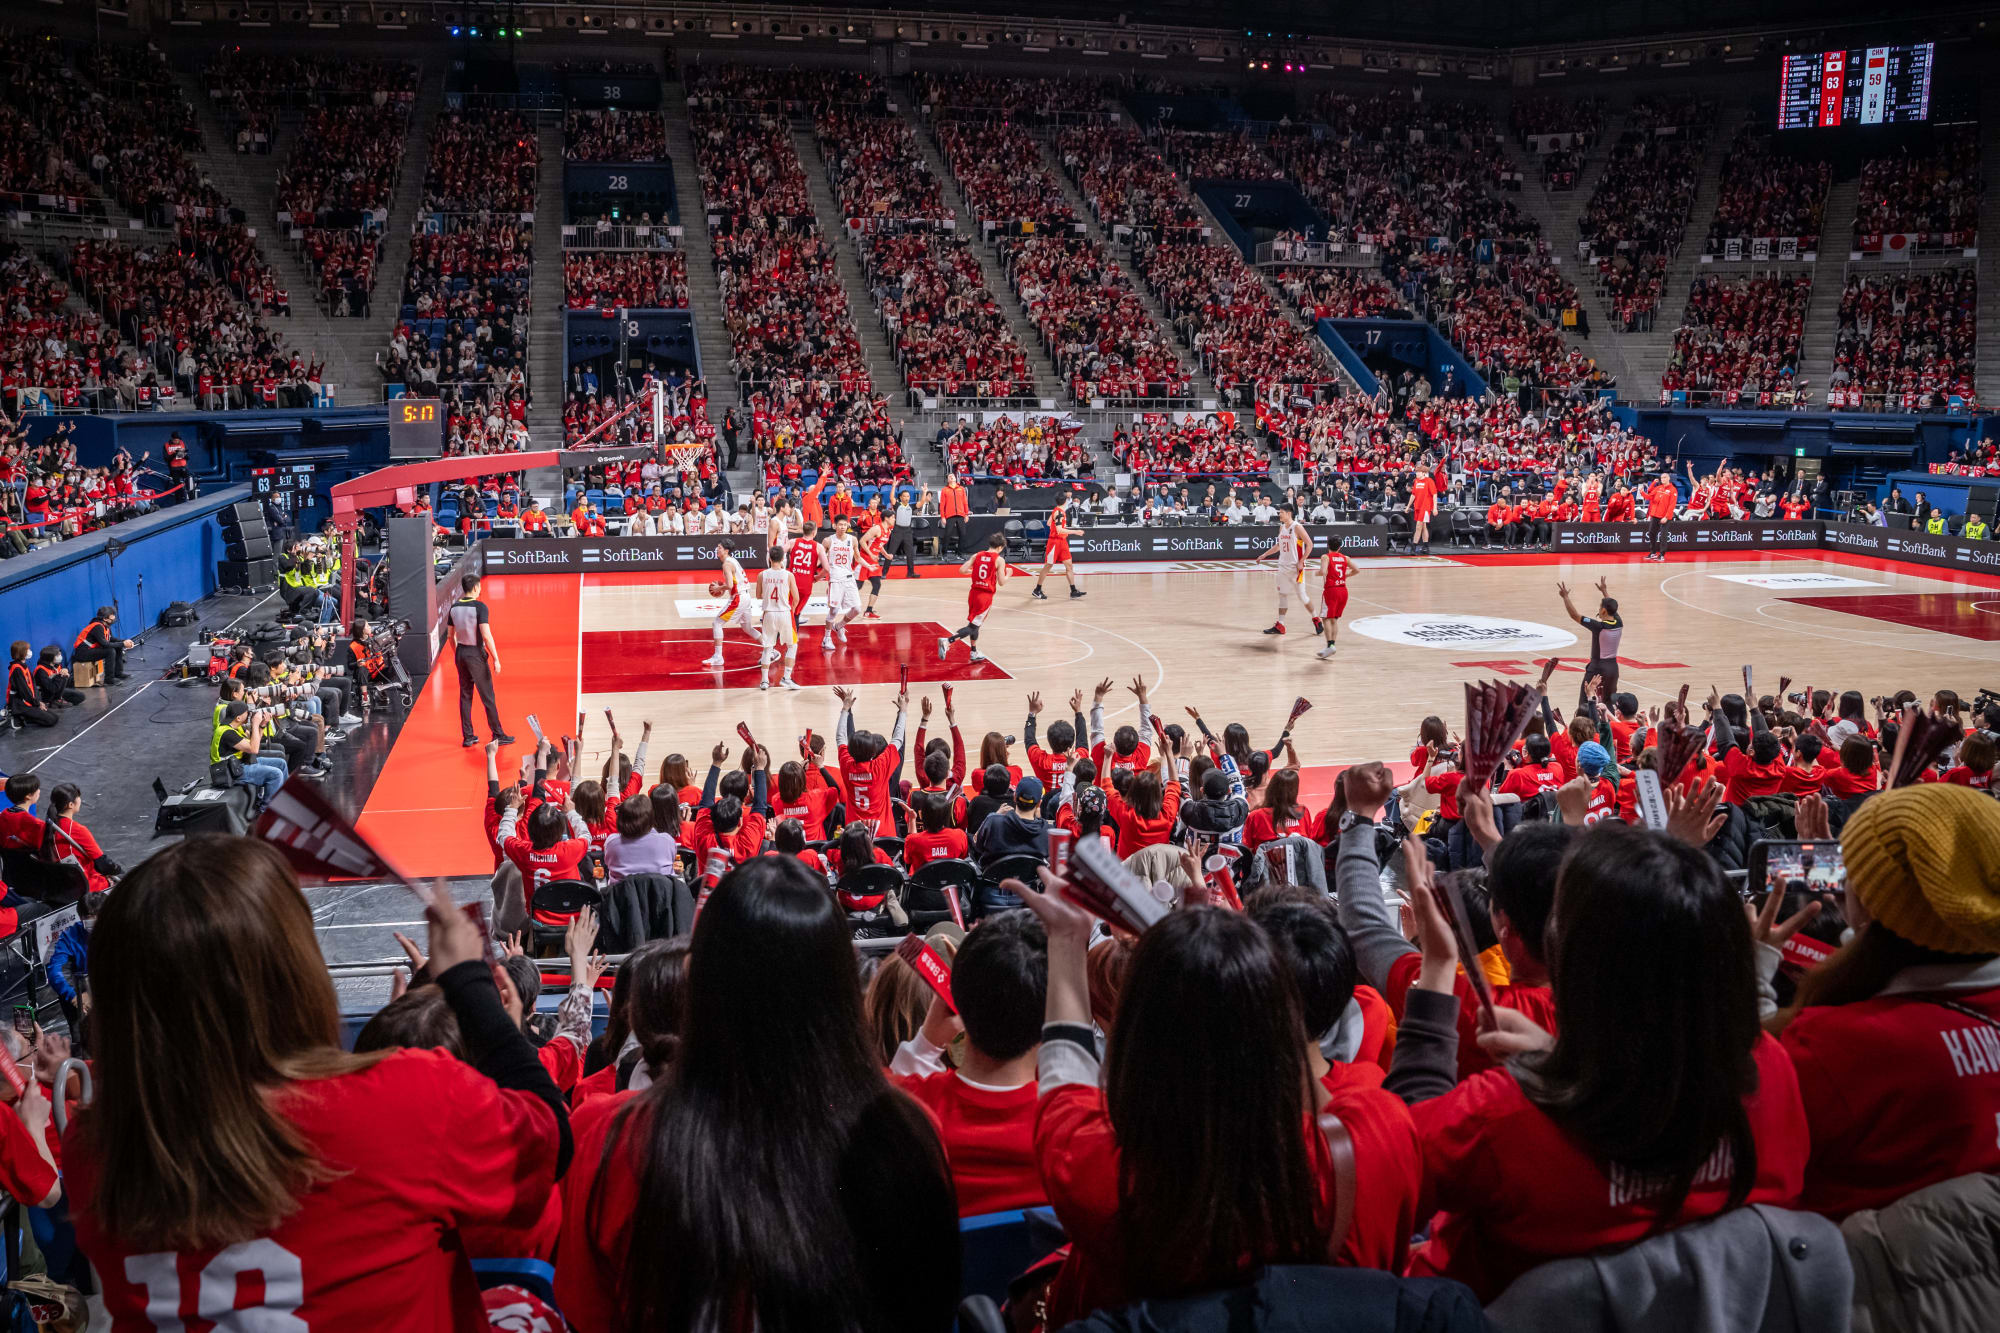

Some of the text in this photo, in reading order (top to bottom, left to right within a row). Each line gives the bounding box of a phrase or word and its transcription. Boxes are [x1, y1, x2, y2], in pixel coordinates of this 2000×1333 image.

[1829, 52, 1841, 60] JPN
[1826, 77, 1839, 89] 63
[1848, 79, 1863, 87] 5:17
[1869, 73, 1881, 86] 59
[603, 87, 621, 99] 38
[1158, 107, 1173, 118] 37
[609, 176, 628, 190] 28
[1234, 195, 1251, 207] 27
[1365, 330, 1382, 344] 17
[403, 405, 434, 422] 5:17
[258, 474, 310, 492] 63 5:17 59
[1577, 529, 1817, 544] SoftBank SfBank SoftBank SoftBank
[1087, 539, 1141, 552] SoftBank
[1170, 538, 1223, 550] SoftBank
[1283, 542, 1290, 552] 21
[1838, 531, 1879, 548] SoftBank
[1901, 541, 1946, 558] SoftBank
[507, 546, 758, 563] SoftBank SoftBank Sofank
[793, 550, 812, 567] 24
[835, 553, 848, 565] 26
[978, 564, 989, 580] 6
[1335, 563, 1343, 578] 5
[770, 586, 779, 603] 4
[1052, 762, 1067, 771] NISH
[854, 786, 870, 811] 5
[529, 852, 558, 863] HIEJIMA
[931, 847, 948, 857] BABA
[533, 868, 552, 888] 6
[1795, 943, 1827, 962] JAPAN
[124, 1237, 310, 1333] 18
